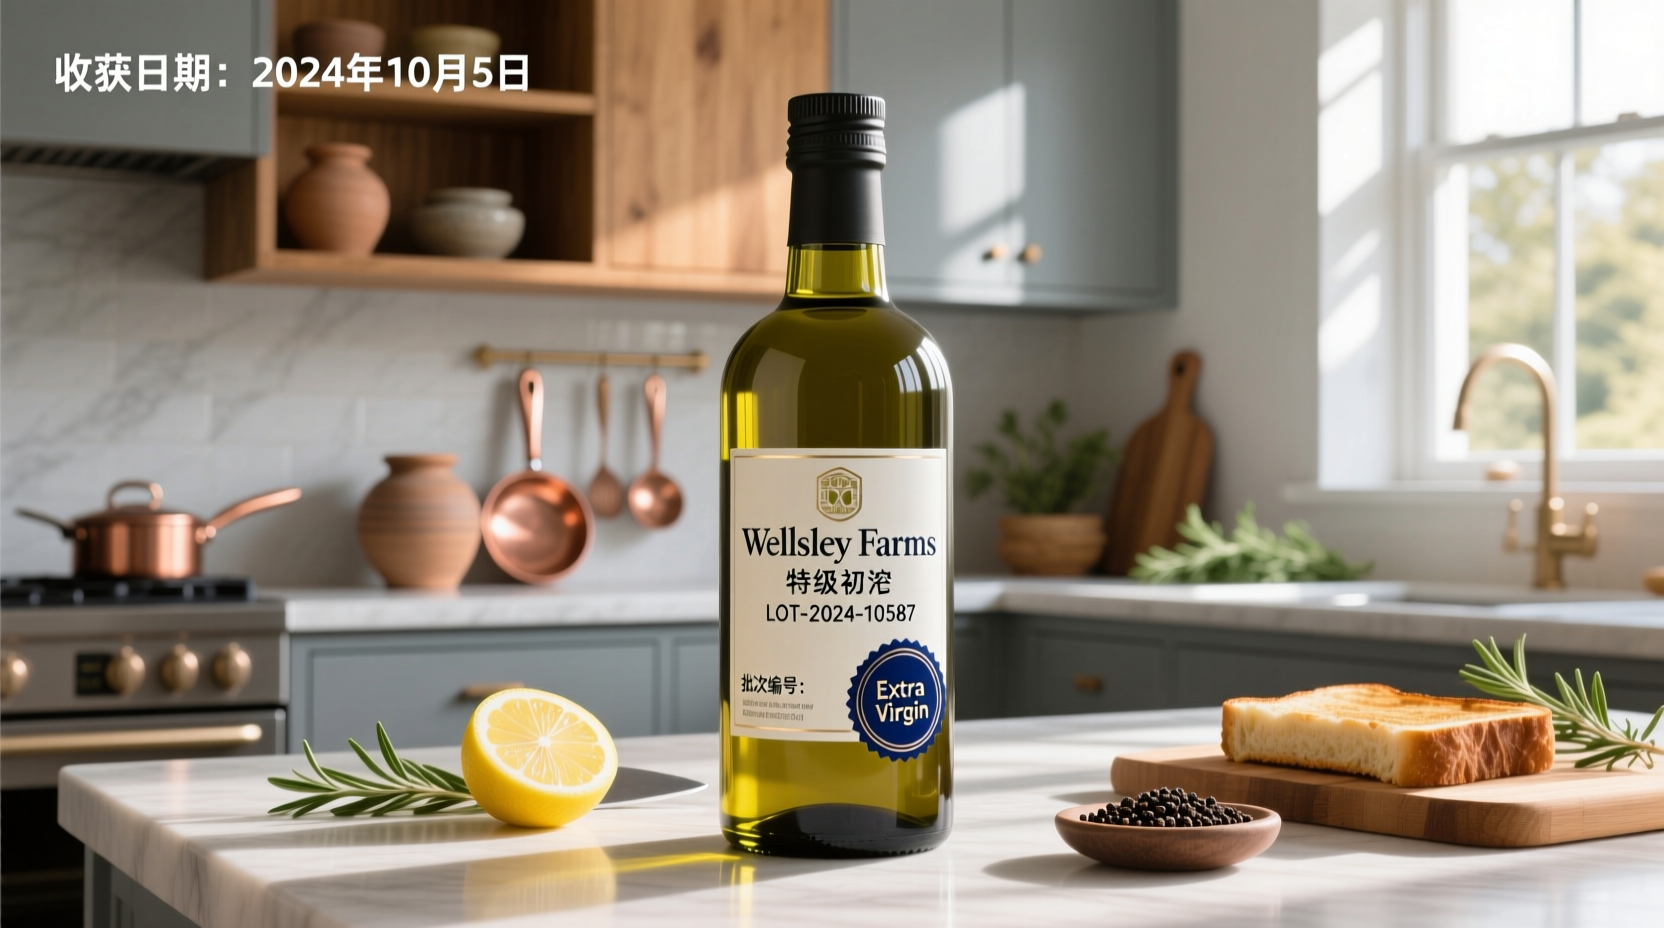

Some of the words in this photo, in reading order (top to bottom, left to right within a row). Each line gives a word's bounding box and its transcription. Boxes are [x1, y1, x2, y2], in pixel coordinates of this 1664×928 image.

[741, 526, 853, 564] Wellsley
[858, 528, 937, 558] Farms
[766, 603, 916, 623] LOT-2024-10587
[876, 679, 925, 700] Extra
[875, 700, 929, 726] Virgin
